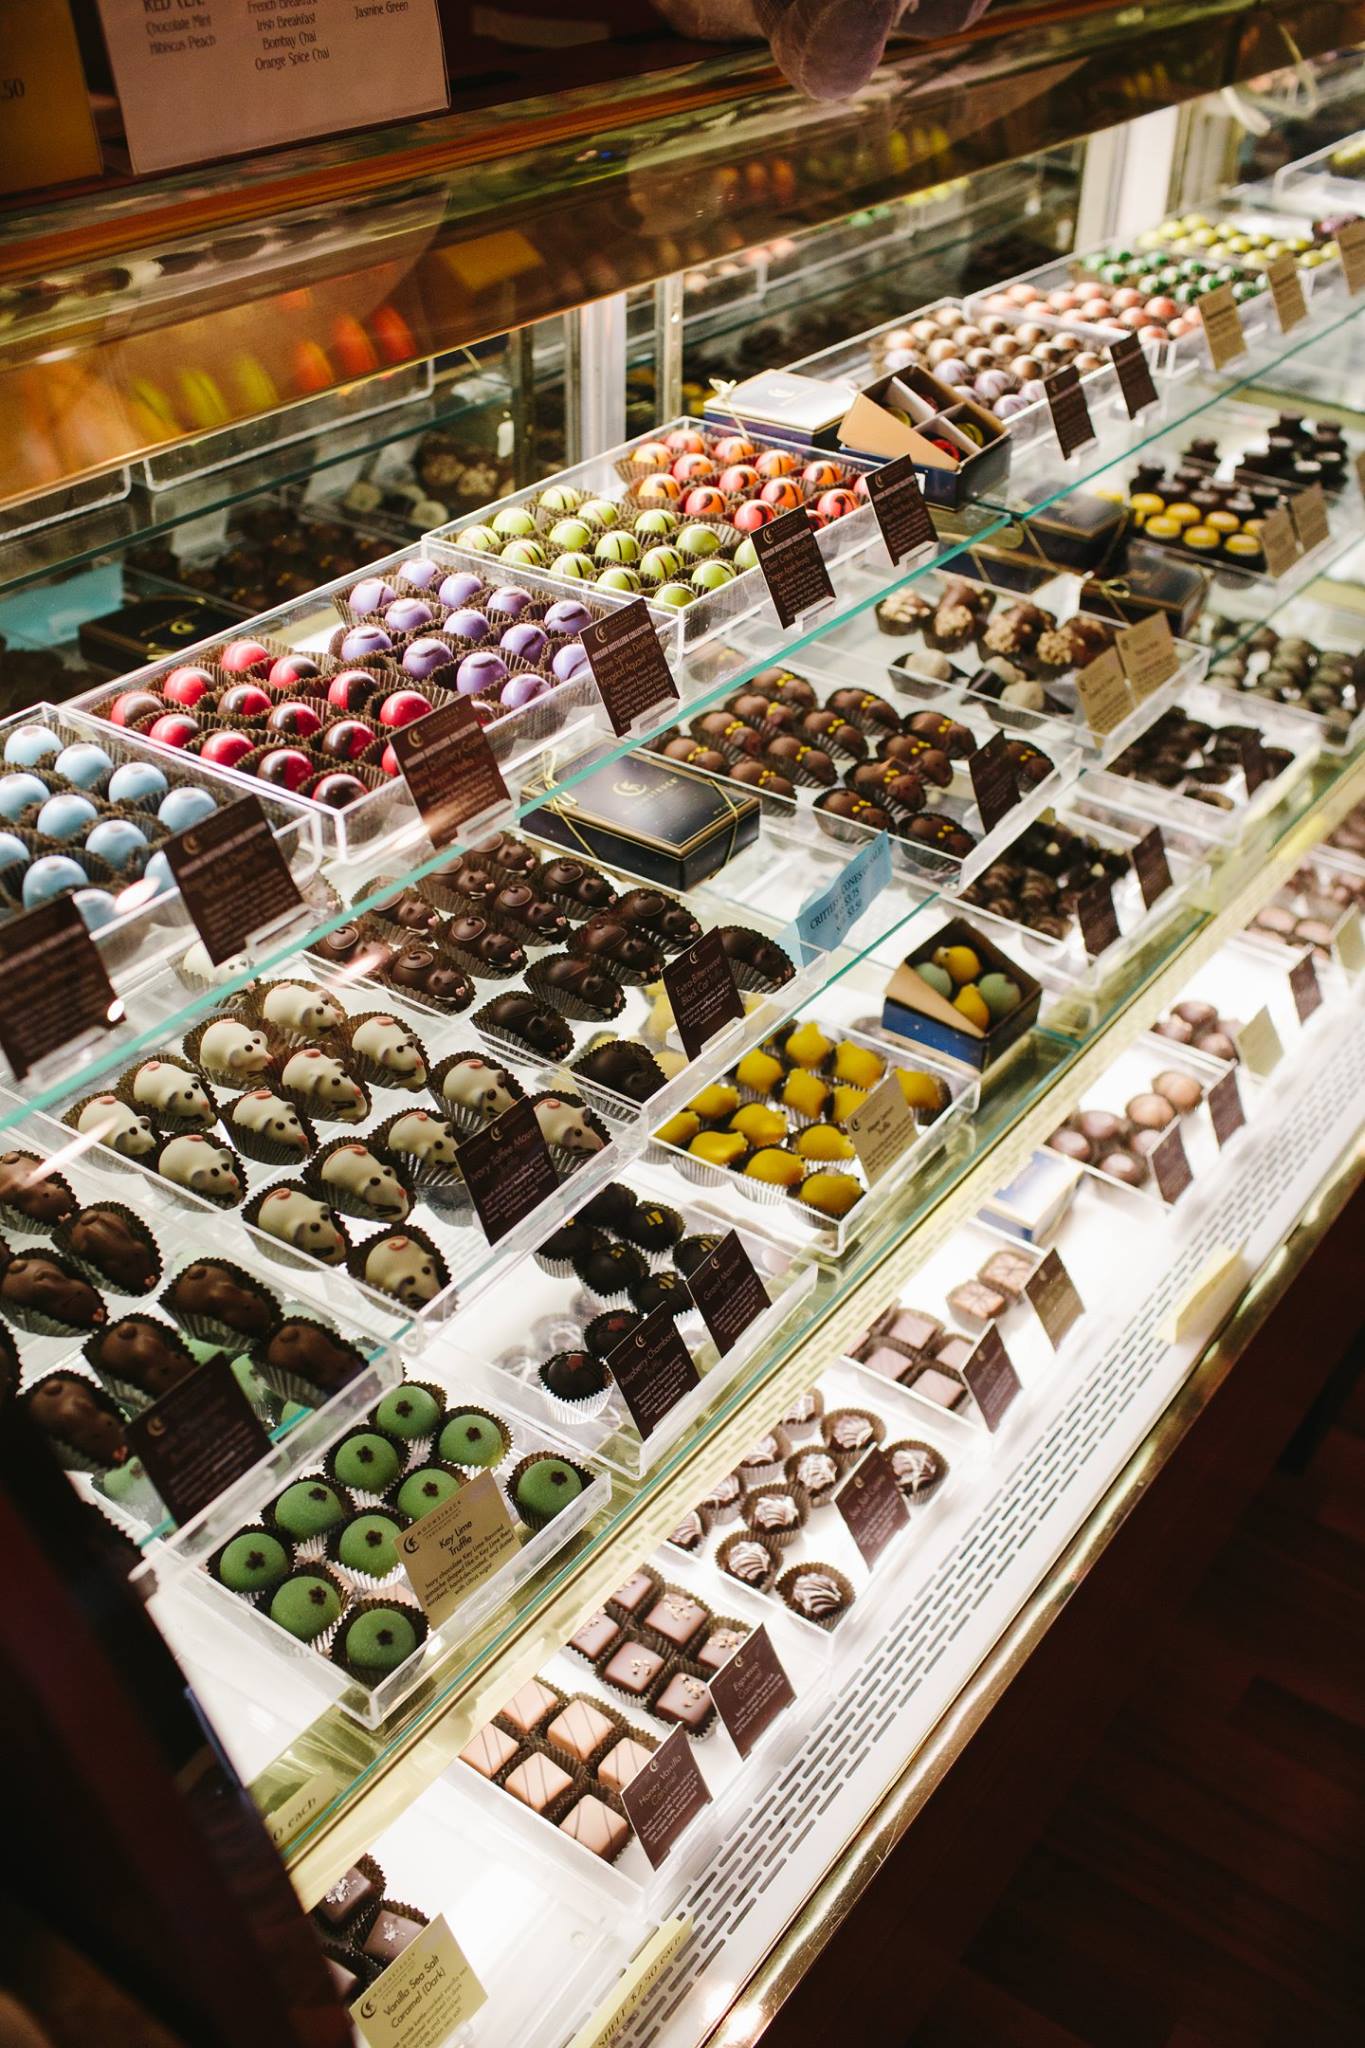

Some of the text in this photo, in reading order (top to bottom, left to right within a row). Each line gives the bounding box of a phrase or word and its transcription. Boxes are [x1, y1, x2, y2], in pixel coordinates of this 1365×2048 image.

[256, 12, 316, 32] Irish Breakfast
[354, 1, 408, 20] Jasmine Green
[262, 36, 296, 50] Bombay
[255, 56, 287, 71] Orange
[288, 51, 310, 66] Spice
[438, 1532, 455, 1552] Key
[454, 1518, 472, 1537] Lime
[448, 1533, 472, 1557] Truffle
[288, 1798, 317, 1828] each
[382, 1986, 410, 2017] Vanilla
[408, 1969, 425, 1990] Sea
[423, 1953, 440, 1973] Salt
[389, 1992, 423, 2029] Caramel
[420, 1967, 446, 1996] (Dark)
